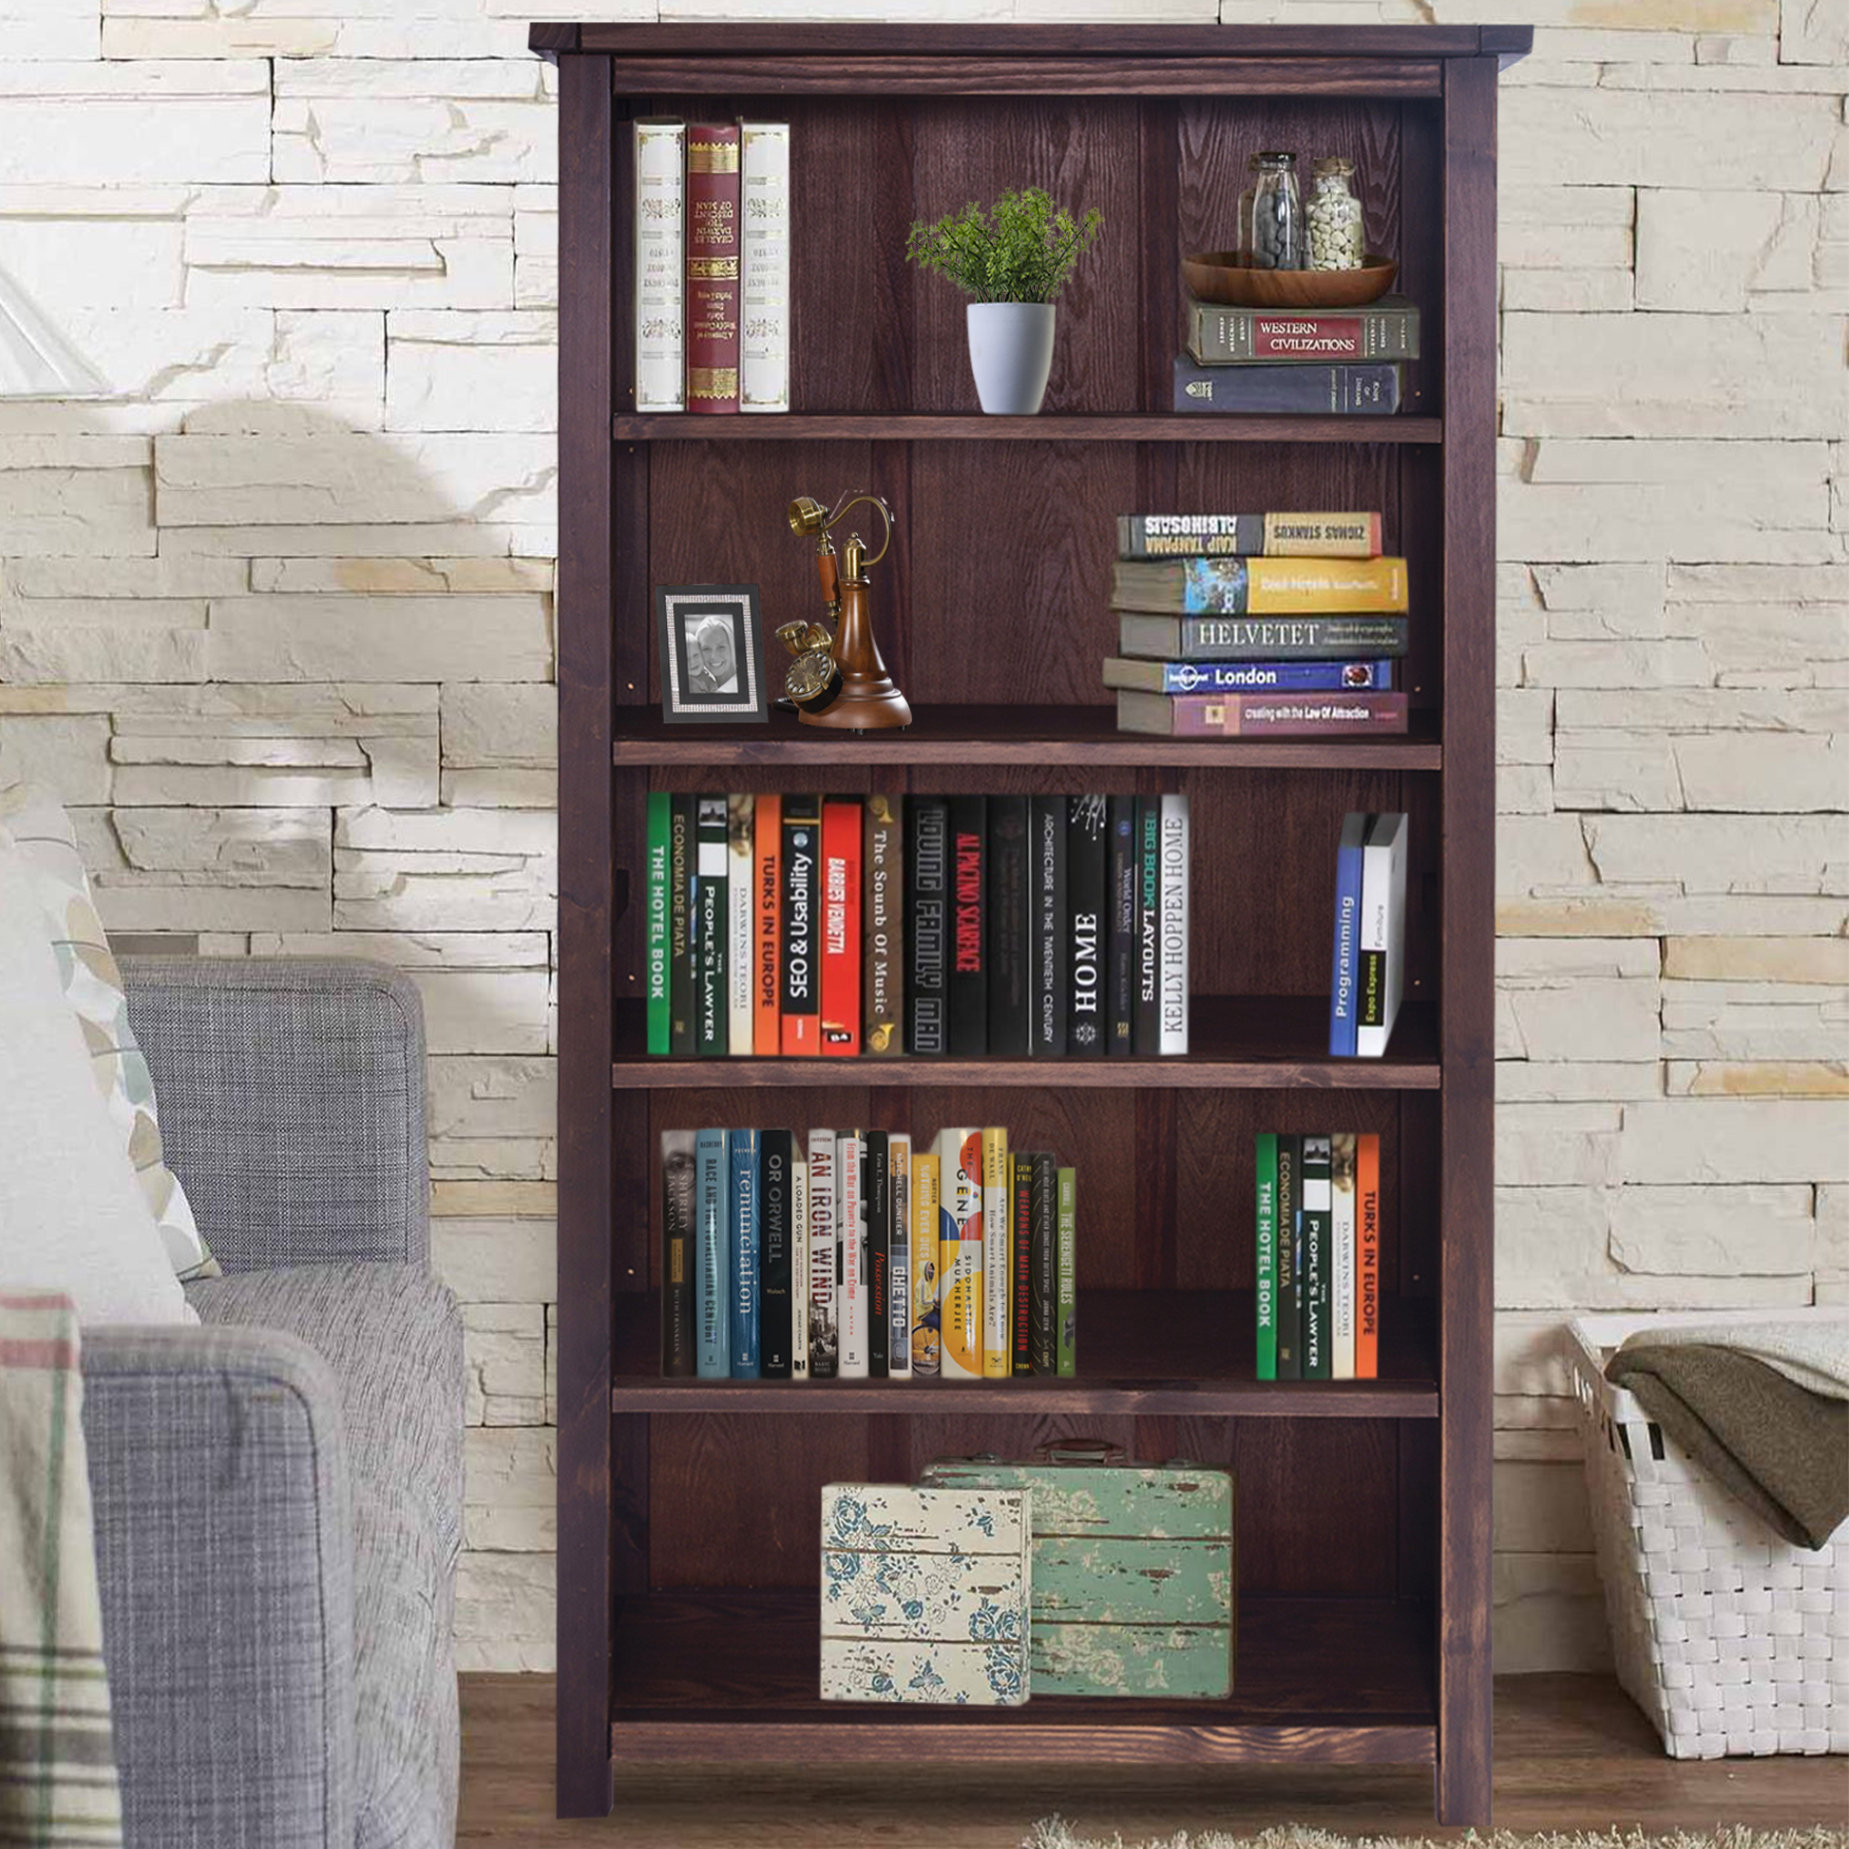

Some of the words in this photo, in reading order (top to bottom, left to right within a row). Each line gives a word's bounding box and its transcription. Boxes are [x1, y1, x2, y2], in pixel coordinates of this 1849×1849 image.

[1260, 322, 1318, 334] WESTERN
[1270, 339, 1355, 351] CIVILIZATIONS
[1145, 515, 1237, 534] ALBINOSAIS
[1273, 525, 1321, 540] STANKUS
[1324, 525, 1365, 540] ZIGMAS
[1145, 536, 1203, 554] TAMPAMA
[1207, 536, 1237, 553] KAIP
[1199, 624, 1320, 646] HELVETET
[1215, 668, 1277, 685] London
[674, 814, 685, 893] ECONOMIA
[874, 830, 888, 864] The
[917, 809, 944, 891] LOVING
[956, 833, 979, 850] AL
[1043, 813, 1054, 891] ARCHITECTURE
[1143, 819, 1157, 850] BIG
[1165, 818, 1183, 877] HOME
[651, 846, 664, 881] THE
[762, 855, 775, 910] TURKS
[956, 852, 979, 903] PACINO
[1143, 853, 1157, 908] BOOK
[790, 853, 812, 936] Usability
[1043, 896, 1054, 908] IN
[1122, 868, 1132, 900] World
[651, 886, 664, 944] HOTEL
[674, 895, 684, 913] DE
[1043, 912, 1054, 931] THE
[1122, 902, 1133, 935] Order
[674, 917, 685, 958] PIATA
[739, 887, 747, 960] DARWINS
[762, 916, 775, 935] IN
[827, 903, 845, 954] VENDETTA
[957, 906, 979, 972] SCARFACE
[1164, 884, 1183, 965] HOPPEN
[1375, 904, 1385, 948] Furniture
[790, 941, 807, 956] &
[874, 934, 888, 956] Of
[915, 900, 944, 989] FAMILY
[1043, 935, 1054, 990] TWENTIETH
[1075, 913, 1096, 1013] HOME
[1141, 910, 1155, 1002] LAYOUTS
[1335, 895, 1354, 1018] Programming
[651, 949, 664, 999] BOOK
[739, 964, 747, 1010] TEORI
[762, 941, 775, 1008] EUROPE
[790, 958, 808, 998] SEO
[874, 961, 889, 1014] Music
[1366, 954, 1378, 995] Express
[705, 970, 715, 1041] LAWYER
[1043, 994, 1054, 1043] CENTURY
[1164, 970, 1183, 1033] KELLY
[1365, 996, 1378, 1022] Expo
[916, 998, 942, 1052] MAN
[768, 1154, 783, 1182] OR
[811, 1151, 832, 1177] AN
[846, 1142, 856, 1160] From
[846, 1162, 856, 1173] the
[705, 1159, 717, 1182] RACE
[846, 1174, 856, 1188] War
[895, 1153, 904, 1196] MITCHELL
[920, 1164, 930, 1207] NOTHING
[1280, 1152, 1291, 1226] ECONOMIA
[667, 1174, 677, 1232] JACKSON
[678, 1174, 688, 1231] SHIRLEY
[705, 1185, 716, 1206] AND
[811, 1187, 833, 1237] IRON
[846, 1190, 855, 1200] on
[874, 1179, 883, 1213] Thompson
[956, 1169, 969, 1227] GENE
[1018, 1190, 1030, 1236] WEAPONS
[1259, 1182, 1271, 1215] THE
[768, 1187, 782, 1264] ORWELL
[845, 1201, 856, 1228] Poverty
[846, 1229, 856, 1237] to
[895, 1198, 904, 1236] DUNEIER
[920, 1210, 930, 1235] EVER
[989, 1209, 997, 1236] How
[999, 1216, 1006, 1231] We
[1061, 1212, 1072, 1229] THE
[1364, 1191, 1376, 1244] TURKS
[739, 1169, 757, 1315] renunciation
[846, 1238, 857, 1251] the
[920, 1237, 930, 1259] DIES
[989, 1237, 997, 1262] Smart
[999, 1233, 1007, 1262] Smart
[1018, 1239, 1030, 1252] OF
[1061, 1231, 1073, 1276] SERENGETI
[1259, 1219, 1271, 1275] HOTEL
[1280, 1228, 1291, 1247] DE
[811, 1247, 833, 1304] WIND
[846, 1251, 857, 1266] War
[847, 1268, 855, 1278] on
[1018, 1255, 1030, 1281] MATH
[1280, 1249, 1291, 1288] PIATA
[1364, 1248, 1375, 1267] IN
[846, 1279, 857, 1300] Crime
[873, 1251, 886, 1316] Possession
[893, 1266, 906, 1328] GHETTO
[954, 1258, 962, 1331] MUKHERJEE
[964, 1255, 972, 1336] SIDDHARTHA
[989, 1263, 997, 1303] Animals
[997, 1263, 1007, 1301] Enough
[1061, 1278, 1073, 1305] RULES
[989, 1305, 997, 1327] Are?
[999, 1302, 1005, 1312] to
[1017, 1285, 1030, 1352] DESTRUCTION
[1259, 1280, 1271, 1327] BOOK
[1363, 1272, 1375, 1335] EUROPE
[999, 1314, 1007, 1340] Know
[1309, 1300, 1319, 1367] LAWYER
